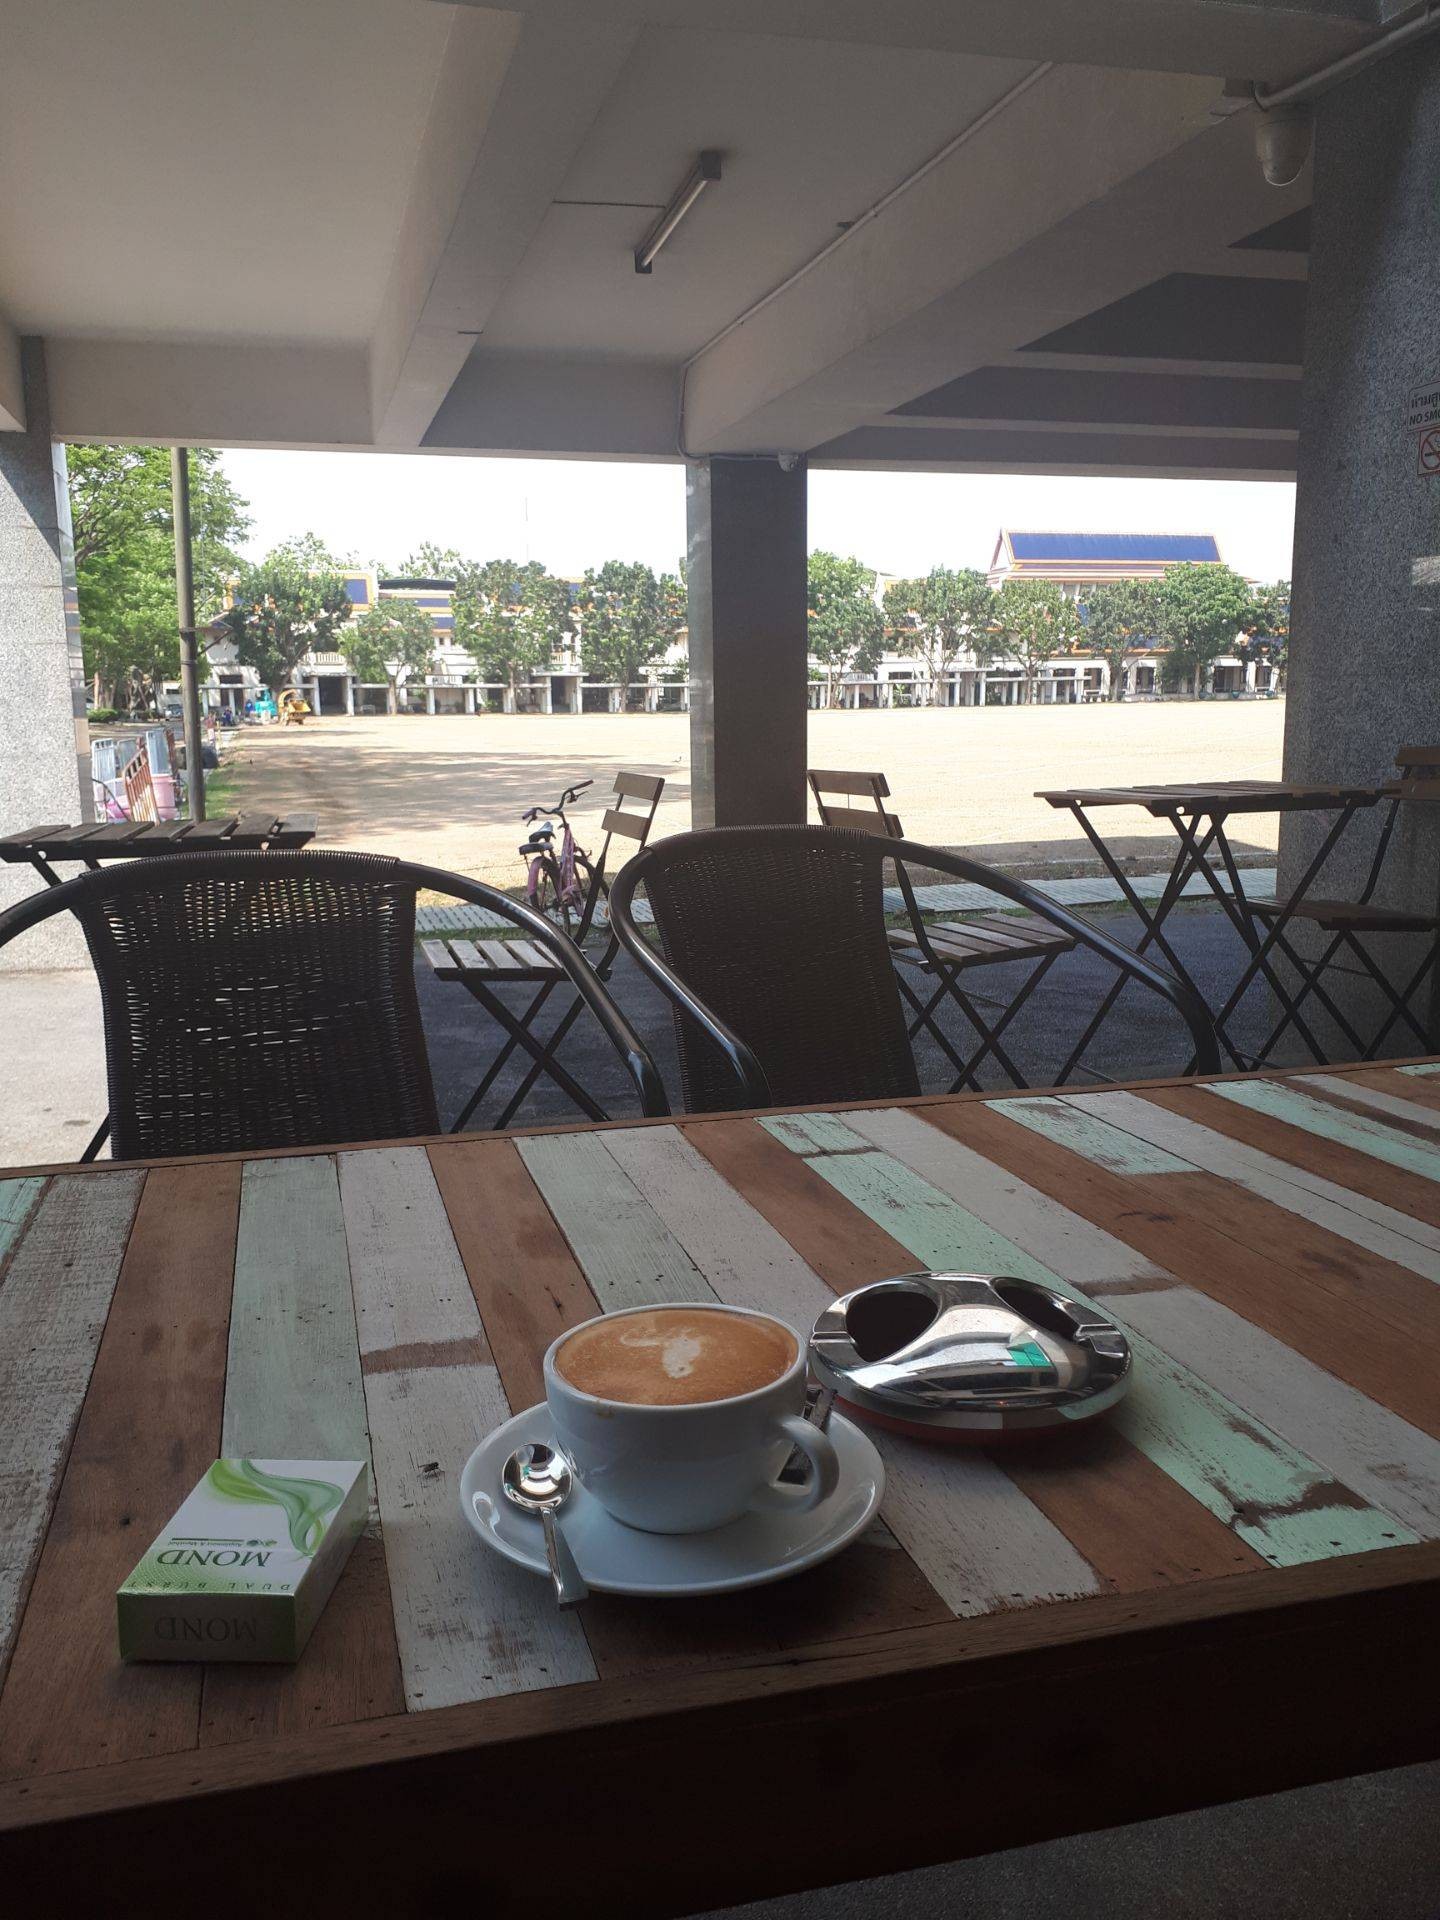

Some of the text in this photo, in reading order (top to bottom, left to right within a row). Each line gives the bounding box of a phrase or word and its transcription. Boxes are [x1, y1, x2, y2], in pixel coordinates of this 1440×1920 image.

[1409, 413, 1422, 426] NO
[157, 1549, 273, 1567] MOND
[128, 1581, 292, 1590] DUAL BURST
[154, 1616, 257, 1642] MOND
